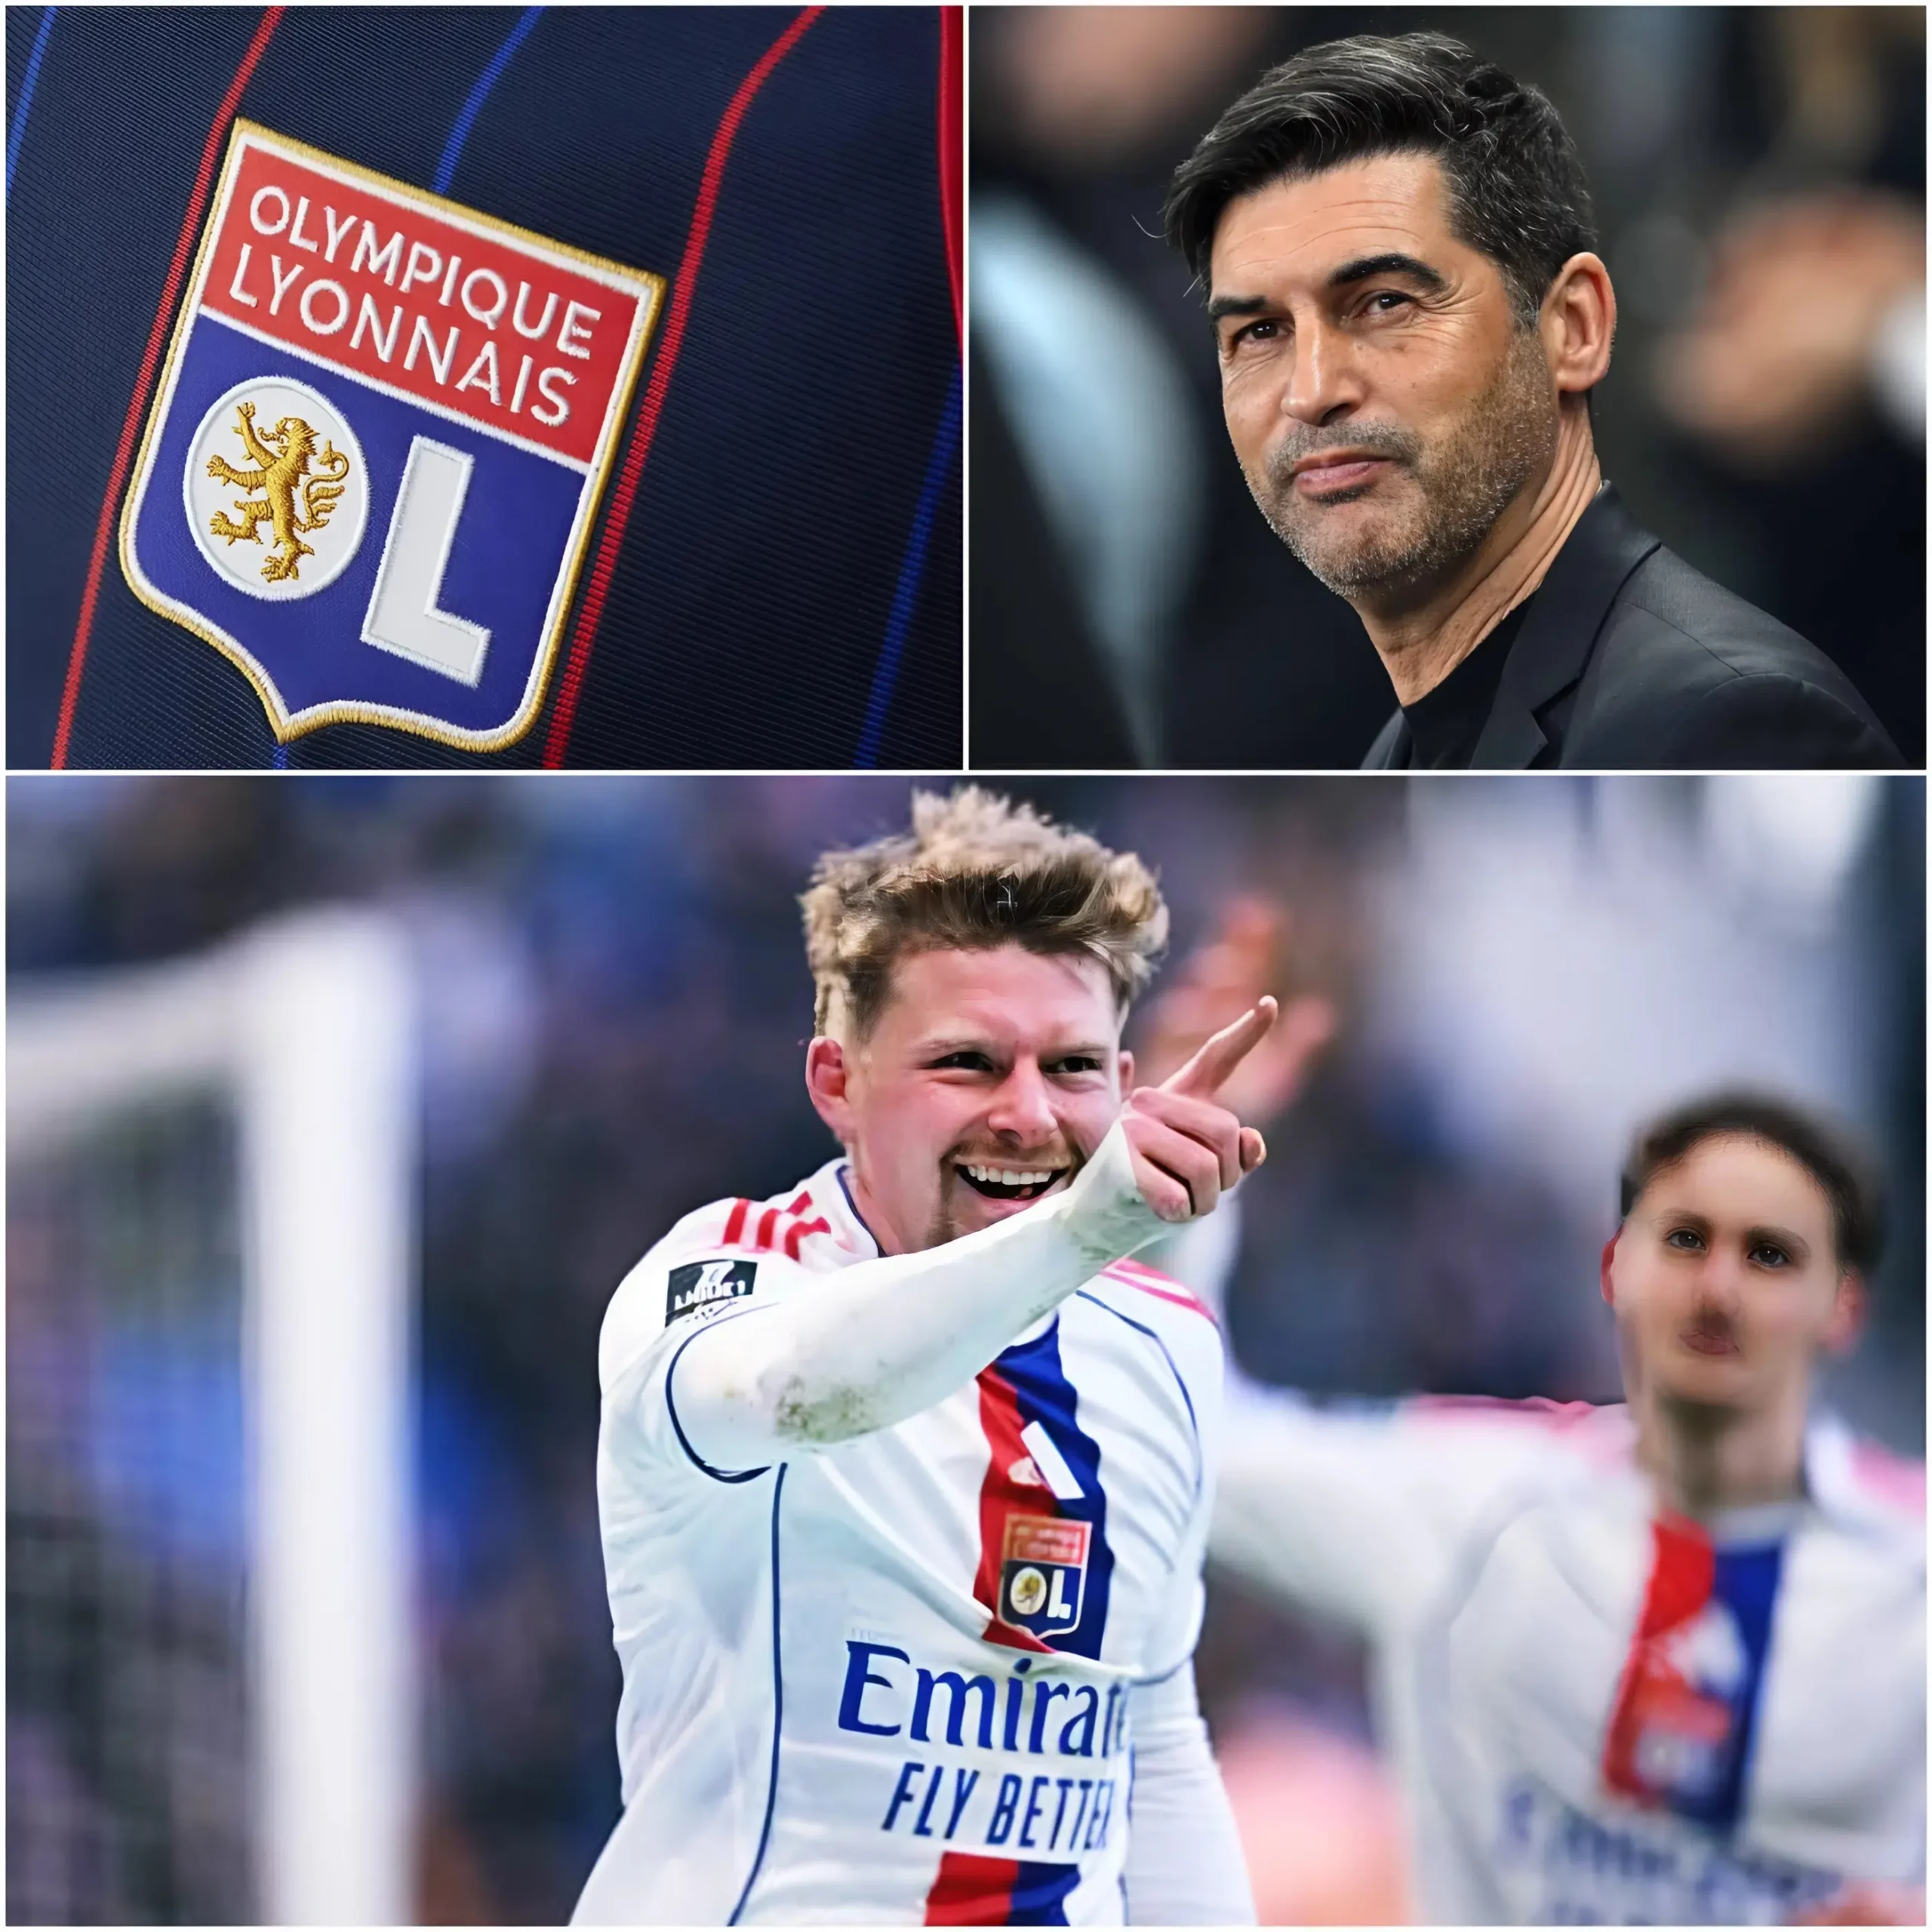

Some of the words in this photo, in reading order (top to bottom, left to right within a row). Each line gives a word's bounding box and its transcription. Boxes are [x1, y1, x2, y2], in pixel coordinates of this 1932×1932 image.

[229, 243, 577, 426] LYONNAIS
[250, 186, 602, 360] OLYMPIQUE
[184, 375, 491, 688] OL
[881, 1761, 980, 1840] FLY
